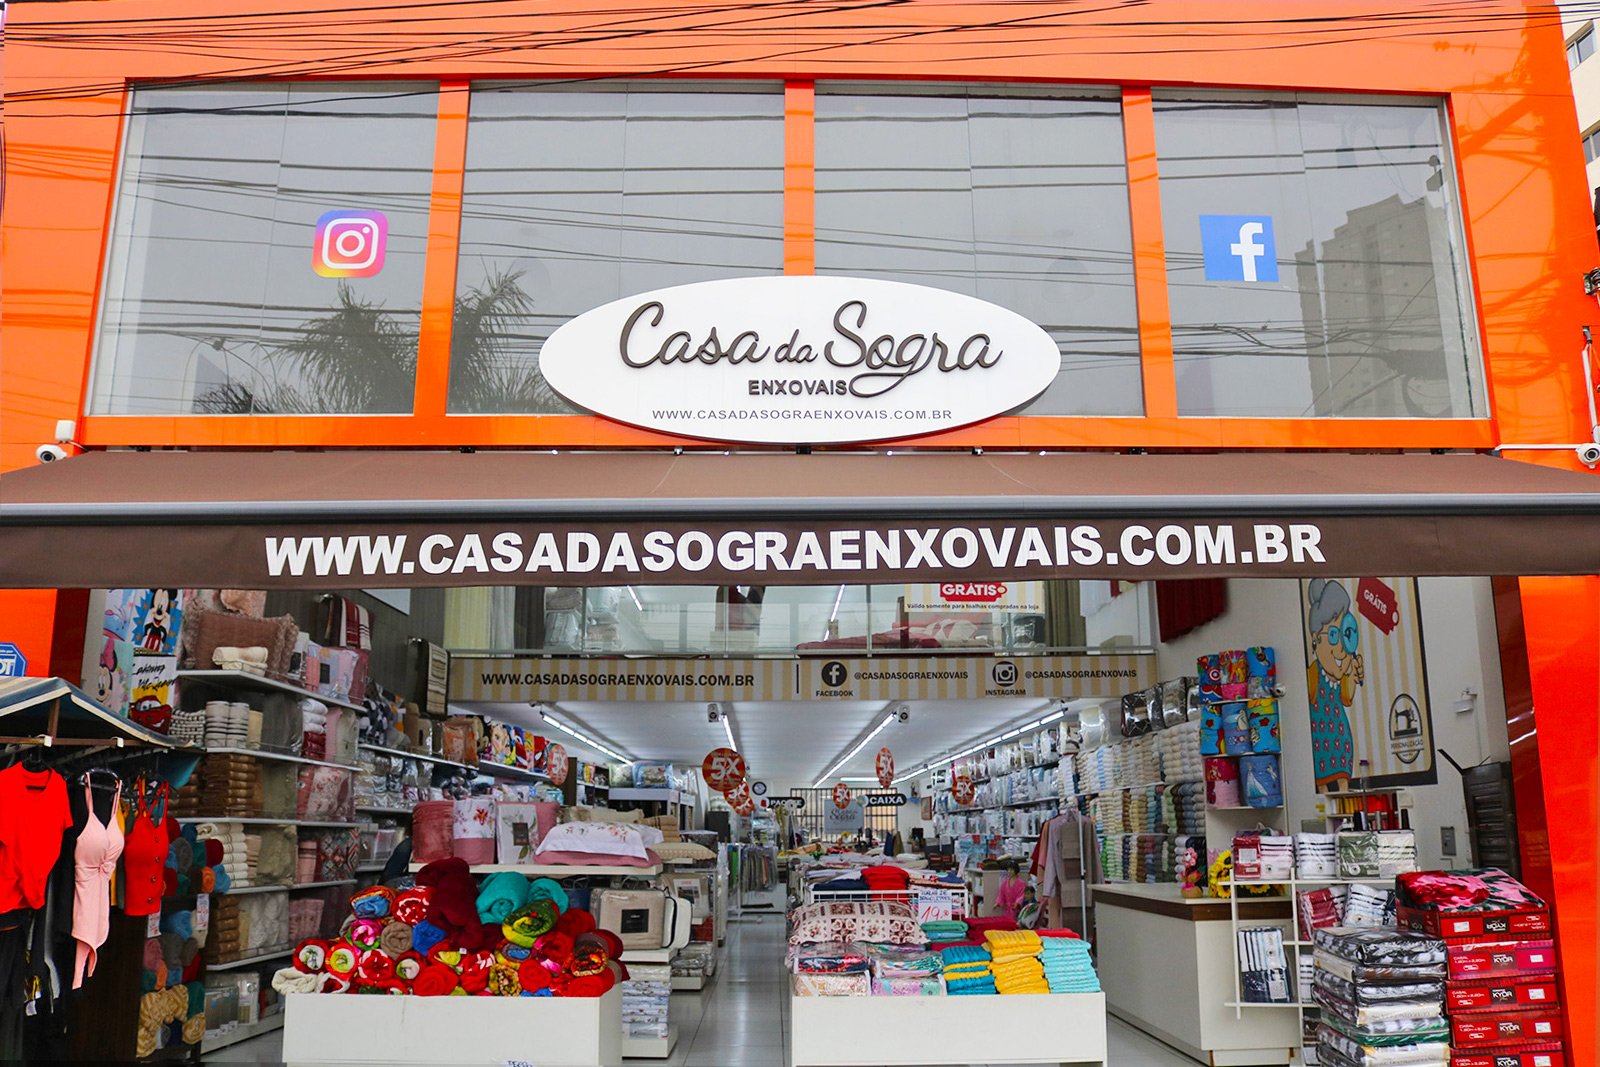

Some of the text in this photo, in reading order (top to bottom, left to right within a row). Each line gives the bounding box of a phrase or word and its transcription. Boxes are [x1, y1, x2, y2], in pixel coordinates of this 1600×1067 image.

[619, 299, 1004, 398] Casa da Sogra
[748, 379, 848, 396] ENXOVAIS
[652, 409, 953, 420] WWW.CASADASOGRAENXOVAIS.COM.BR
[265, 524, 1327, 577] WWW.CASADASOGRAENXOVAIS.COM.BR
[1363, 589, 1388, 615] GRÁTIS
[481, 673, 755, 686] WWW.CASADASOGRAENXOVAIS.COM.BR
[854, 671, 969, 680] @CASADASOGRAENXOVAIS
[1025, 669, 1137, 679] @CASADASOGRAENXOVAIS
[815, 689, 854, 697] FACEBOOK
[985, 688, 1027, 696] INSTAGRAM
[711, 757, 740, 780] 5X
[880, 754, 893, 779] 5X
[836, 788, 849, 802] 5X
[956, 784, 972, 798] 5X
[869, 796, 904, 805] CAIXA
